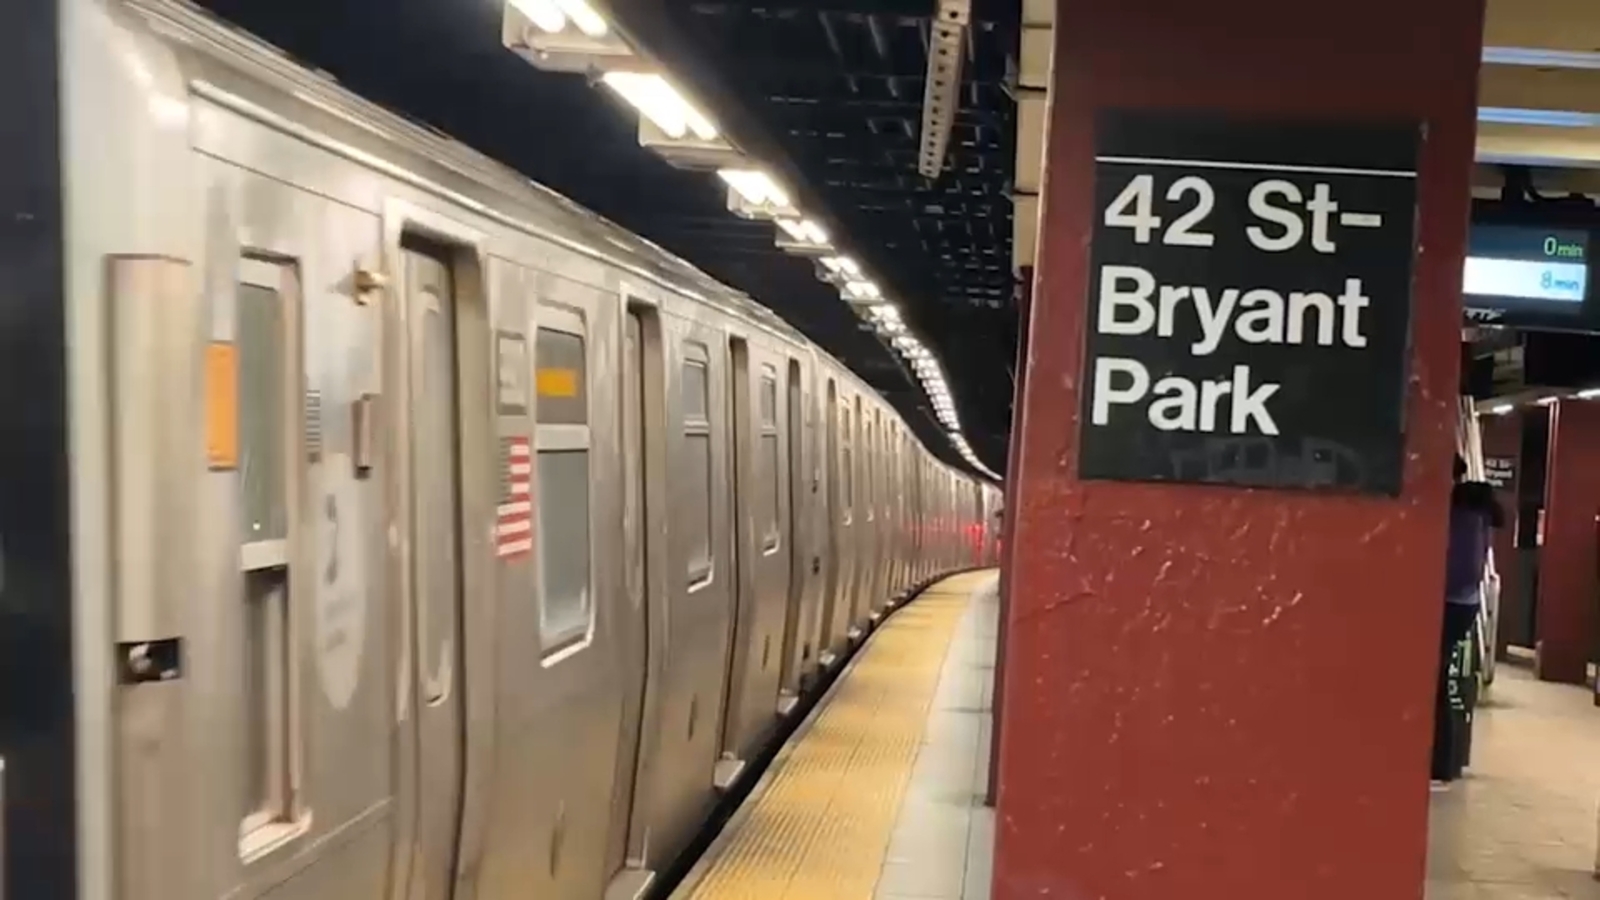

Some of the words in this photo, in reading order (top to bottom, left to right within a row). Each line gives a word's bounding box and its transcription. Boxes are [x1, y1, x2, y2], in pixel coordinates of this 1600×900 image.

[1104, 174, 1215, 247] 42
[1098, 265, 1370, 356] Bryant
[1092, 357, 1281, 436] Park
